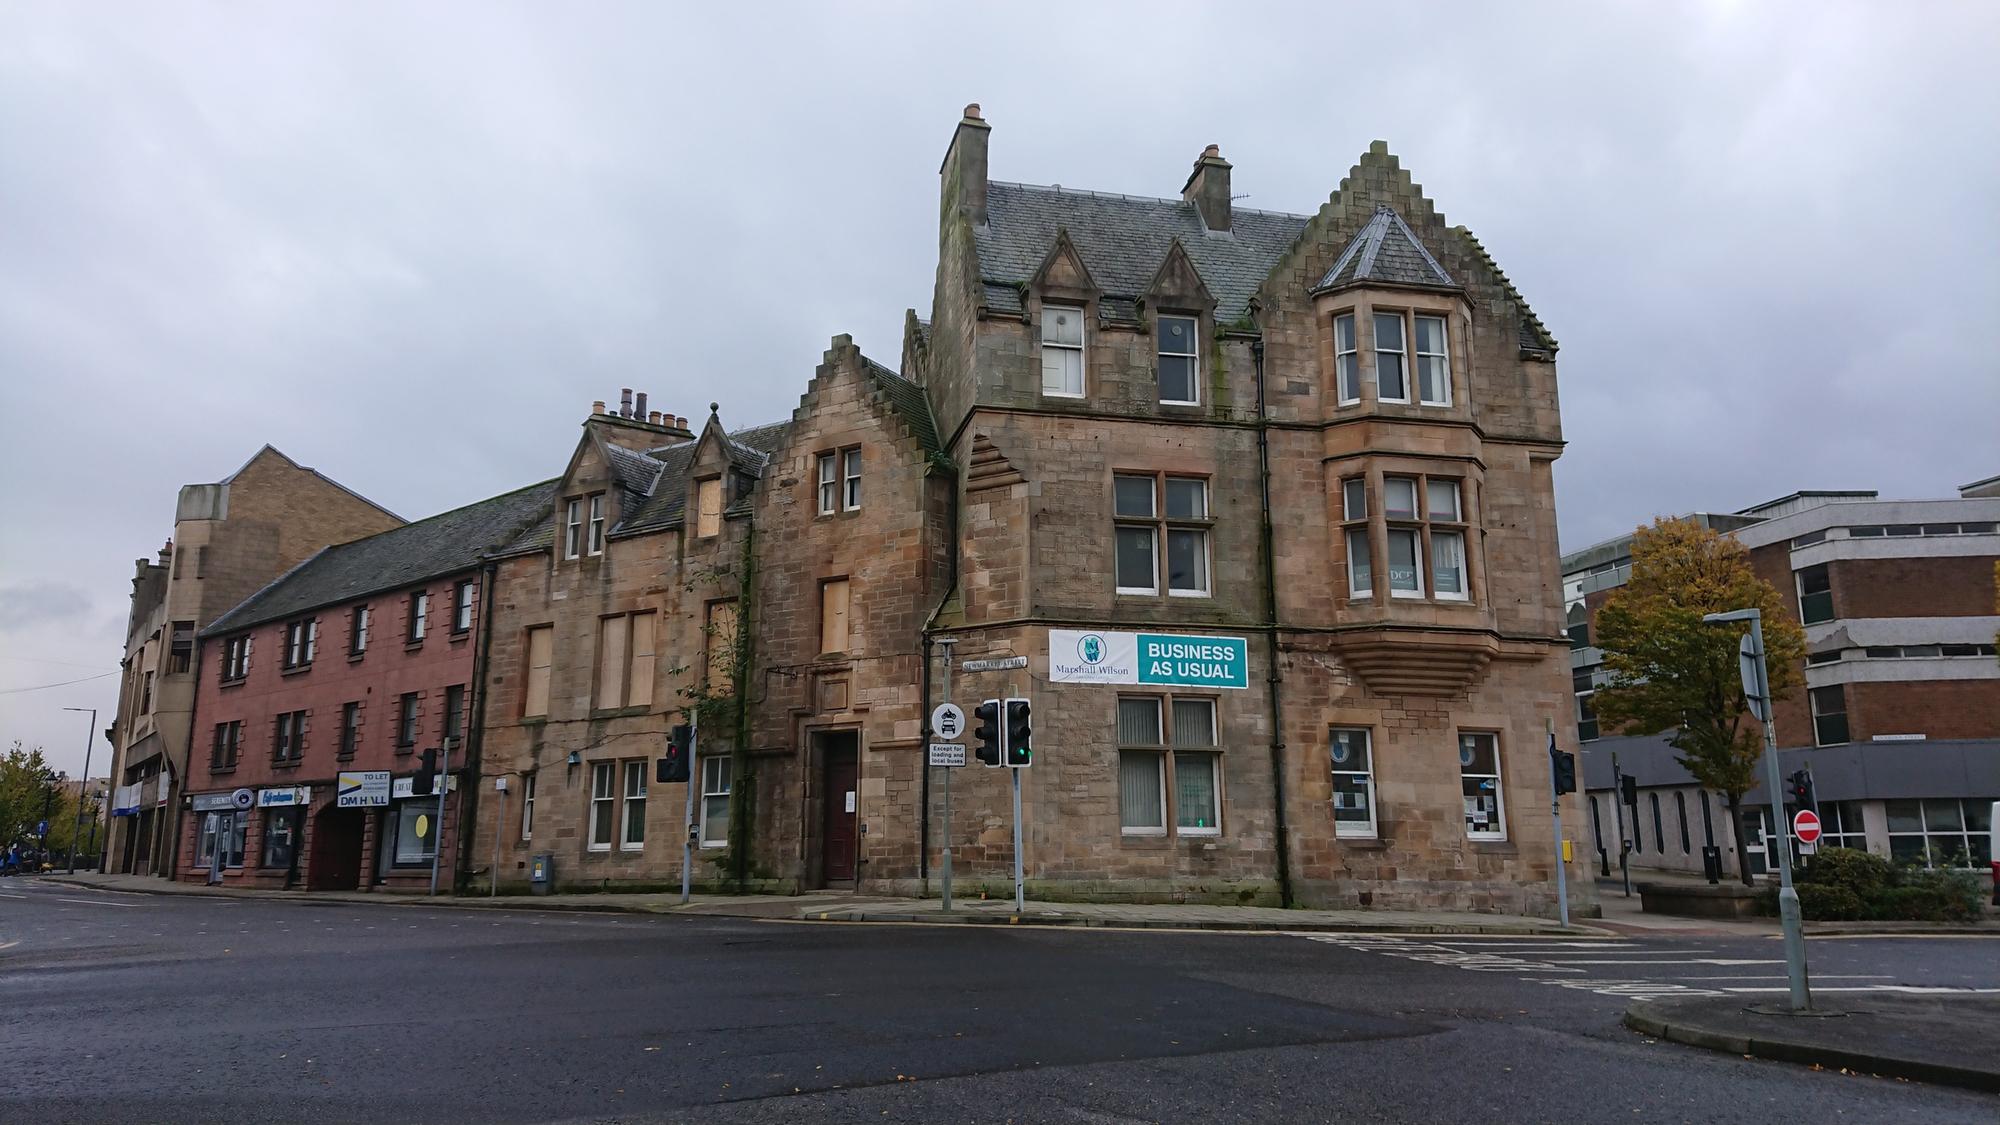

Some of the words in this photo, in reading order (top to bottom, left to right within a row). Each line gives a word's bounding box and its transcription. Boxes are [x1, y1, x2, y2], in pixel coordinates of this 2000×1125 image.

[1148, 643, 1235, 661] BUSINESS
[1002, 658, 1025, 667] STREET
[1055, 664, 1096, 675] Marshall
[1099, 665, 1129, 676] Wilson
[1149, 661, 1173, 676] AS
[1177, 662, 1235, 679] USUAL
[340, 796, 358, 806] DM
